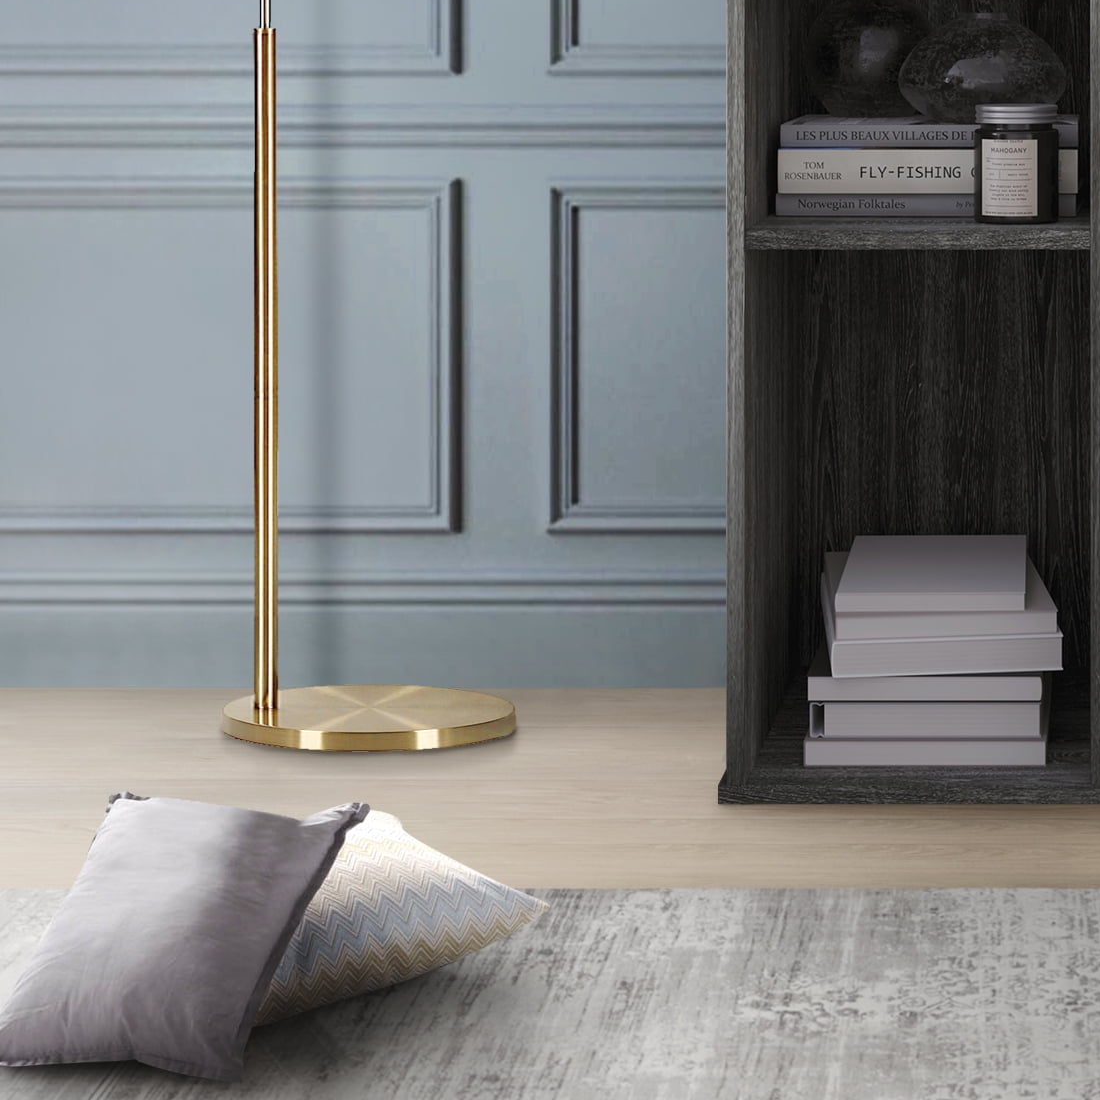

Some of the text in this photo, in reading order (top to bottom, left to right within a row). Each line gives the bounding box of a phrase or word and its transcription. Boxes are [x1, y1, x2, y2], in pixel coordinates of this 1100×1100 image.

[796, 131, 816, 142] LES
[818, 131, 848, 142] PLUS
[851, 131, 890, 142] BEAUX
[892, 131, 949, 142] VILLAGES
[951, 131, 967, 142] DE
[803, 161, 825, 170] TOM
[784, 171, 842, 181] ROSENBAUER
[859, 166, 962, 179] FLY-FISHING
[797, 199, 855, 210] Norwegian
[858, 199, 906, 209] Folktales
